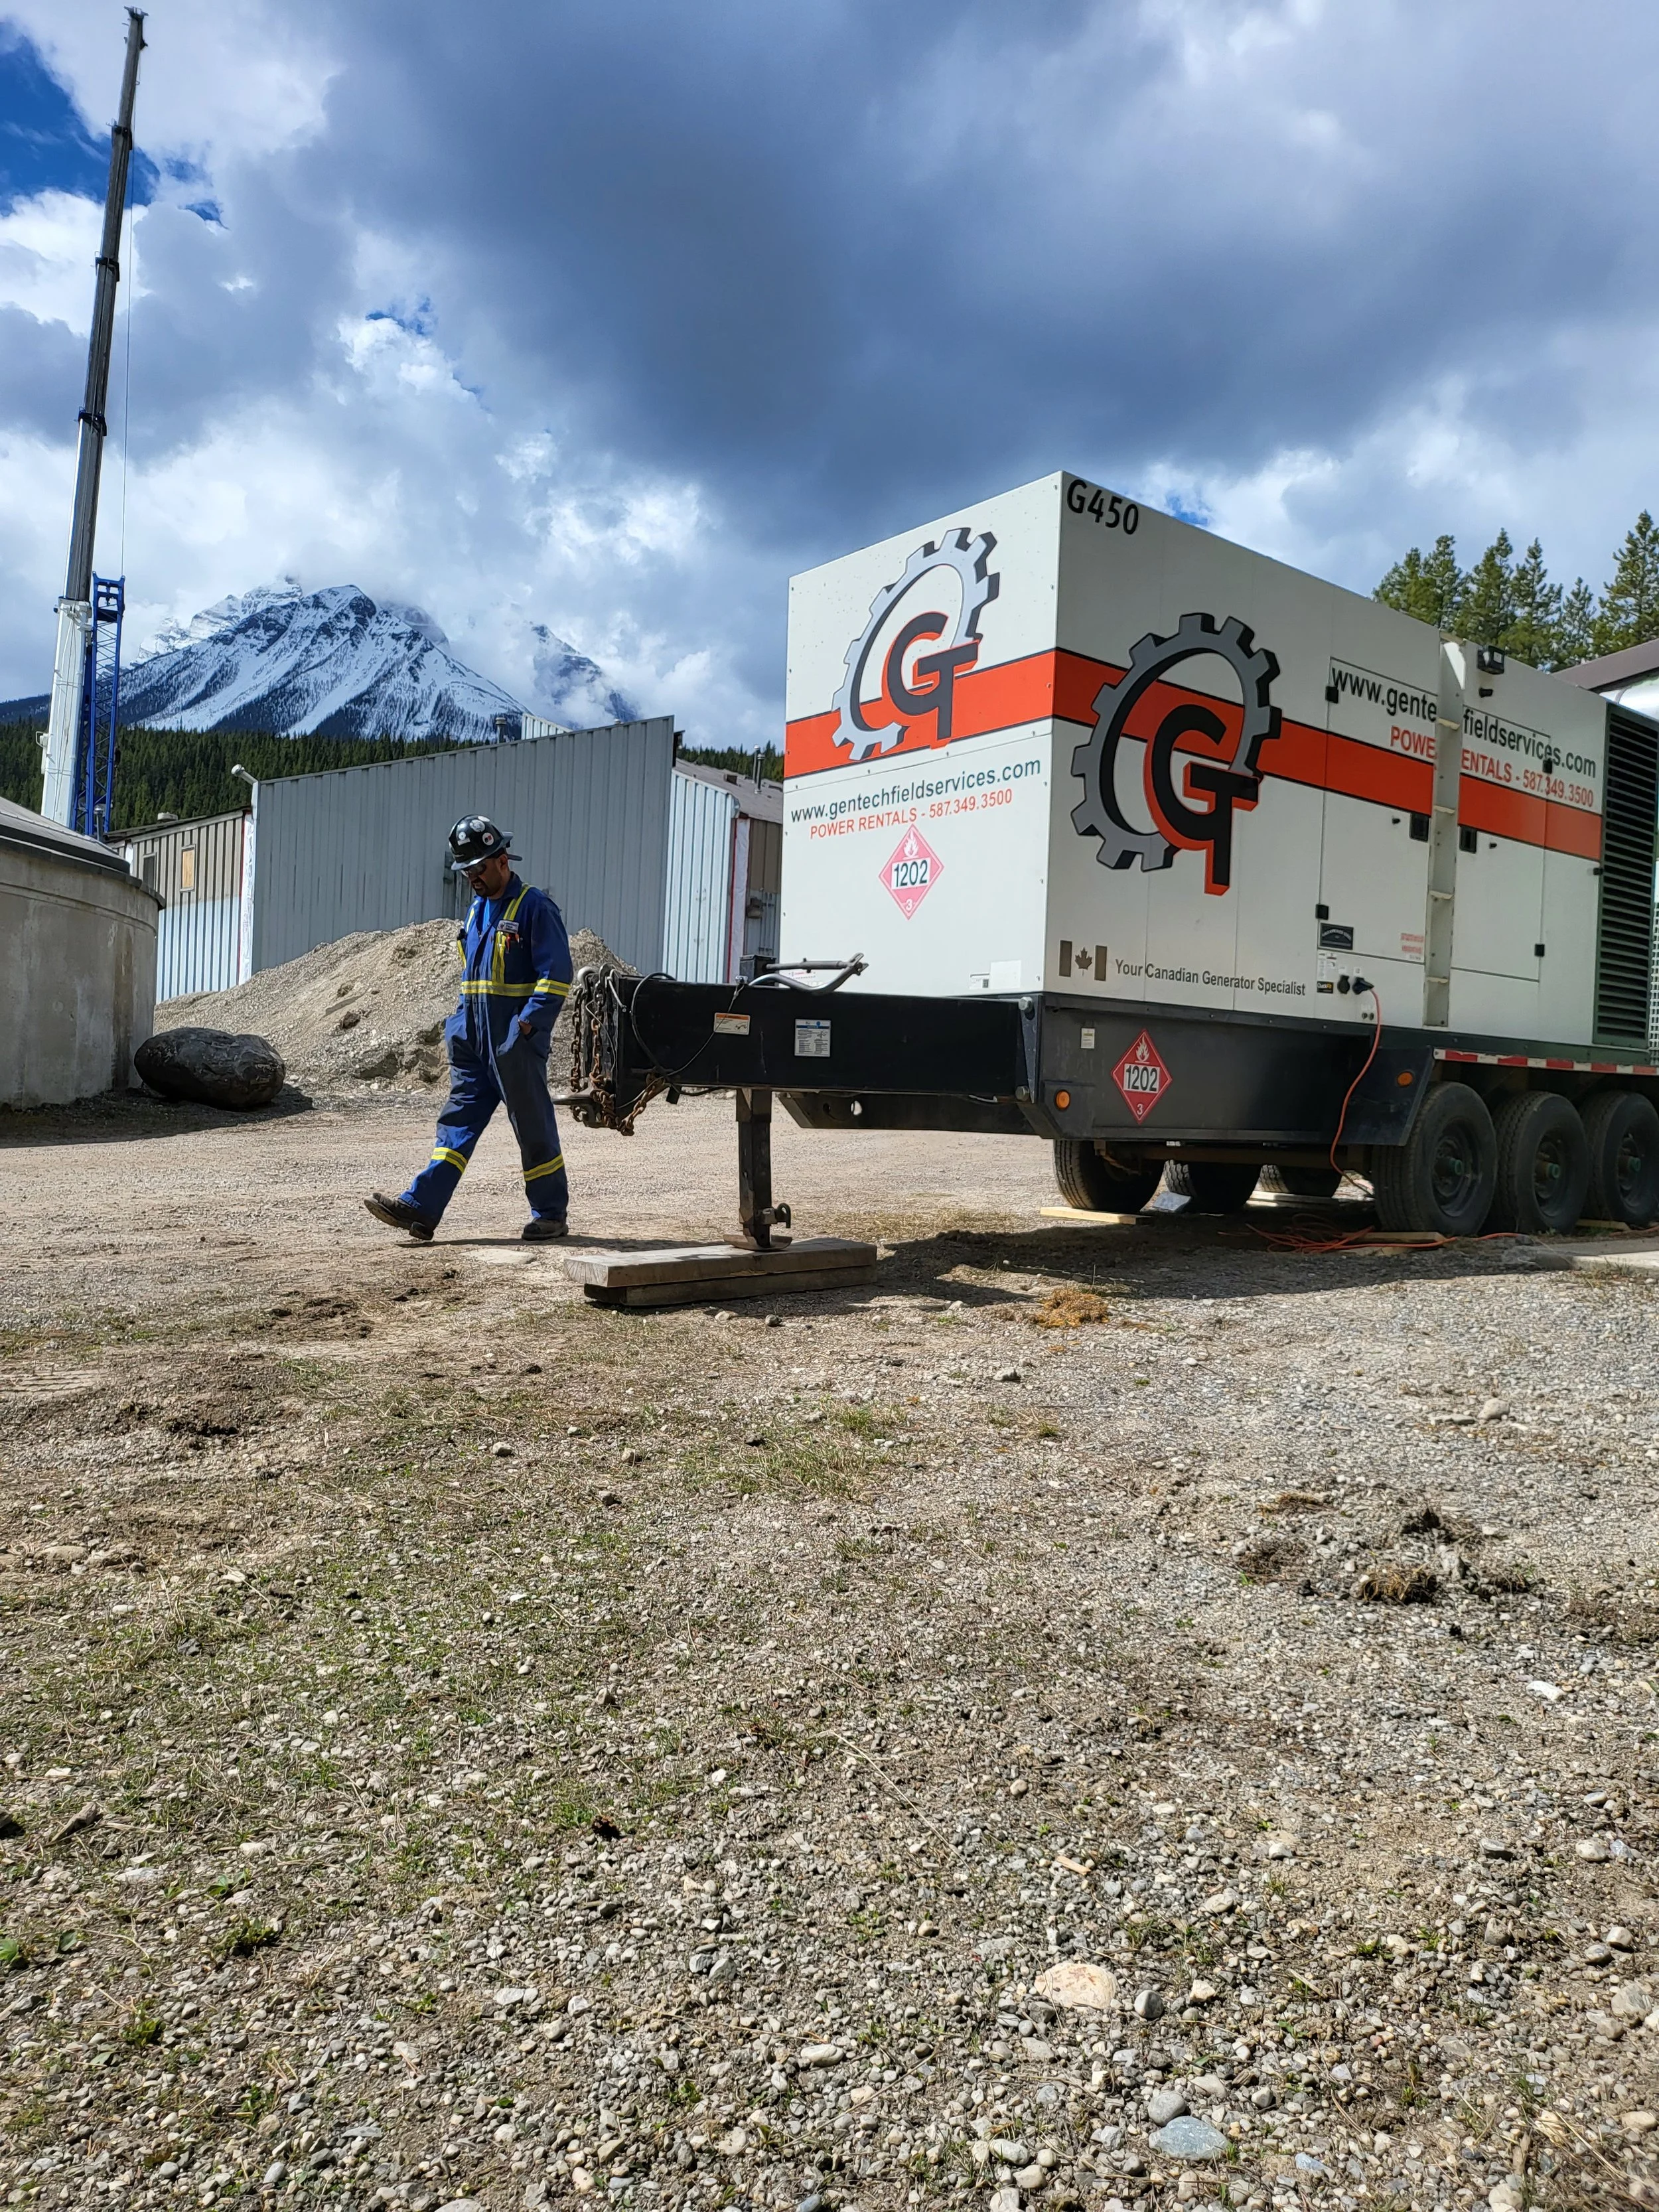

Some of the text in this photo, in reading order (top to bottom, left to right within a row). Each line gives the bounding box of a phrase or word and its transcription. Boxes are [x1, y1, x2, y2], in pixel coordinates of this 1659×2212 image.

[1066, 479, 1140, 536] G450
[1332, 668, 1596, 778] www.gentefieldservices.com
[1390, 725, 1437, 759] POWE
[1461, 748, 1512, 783] ENTALS
[1522, 769, 1594, 808] 587.349.3500
[791, 759, 1041, 823] www.gentechfieldservices.com
[810, 818, 855, 840] POWER
[858, 807, 918, 832] RENTALS
[929, 788, 1013, 818] 587.349.3500
[894, 859, 928, 887] 1202
[905, 898, 913, 912] 3
[1115, 958, 1306, 996] Your Canadian Generator Specialist
[1125, 1065, 1158, 1092] 1202
[1136, 1103, 1143, 1116] 3
